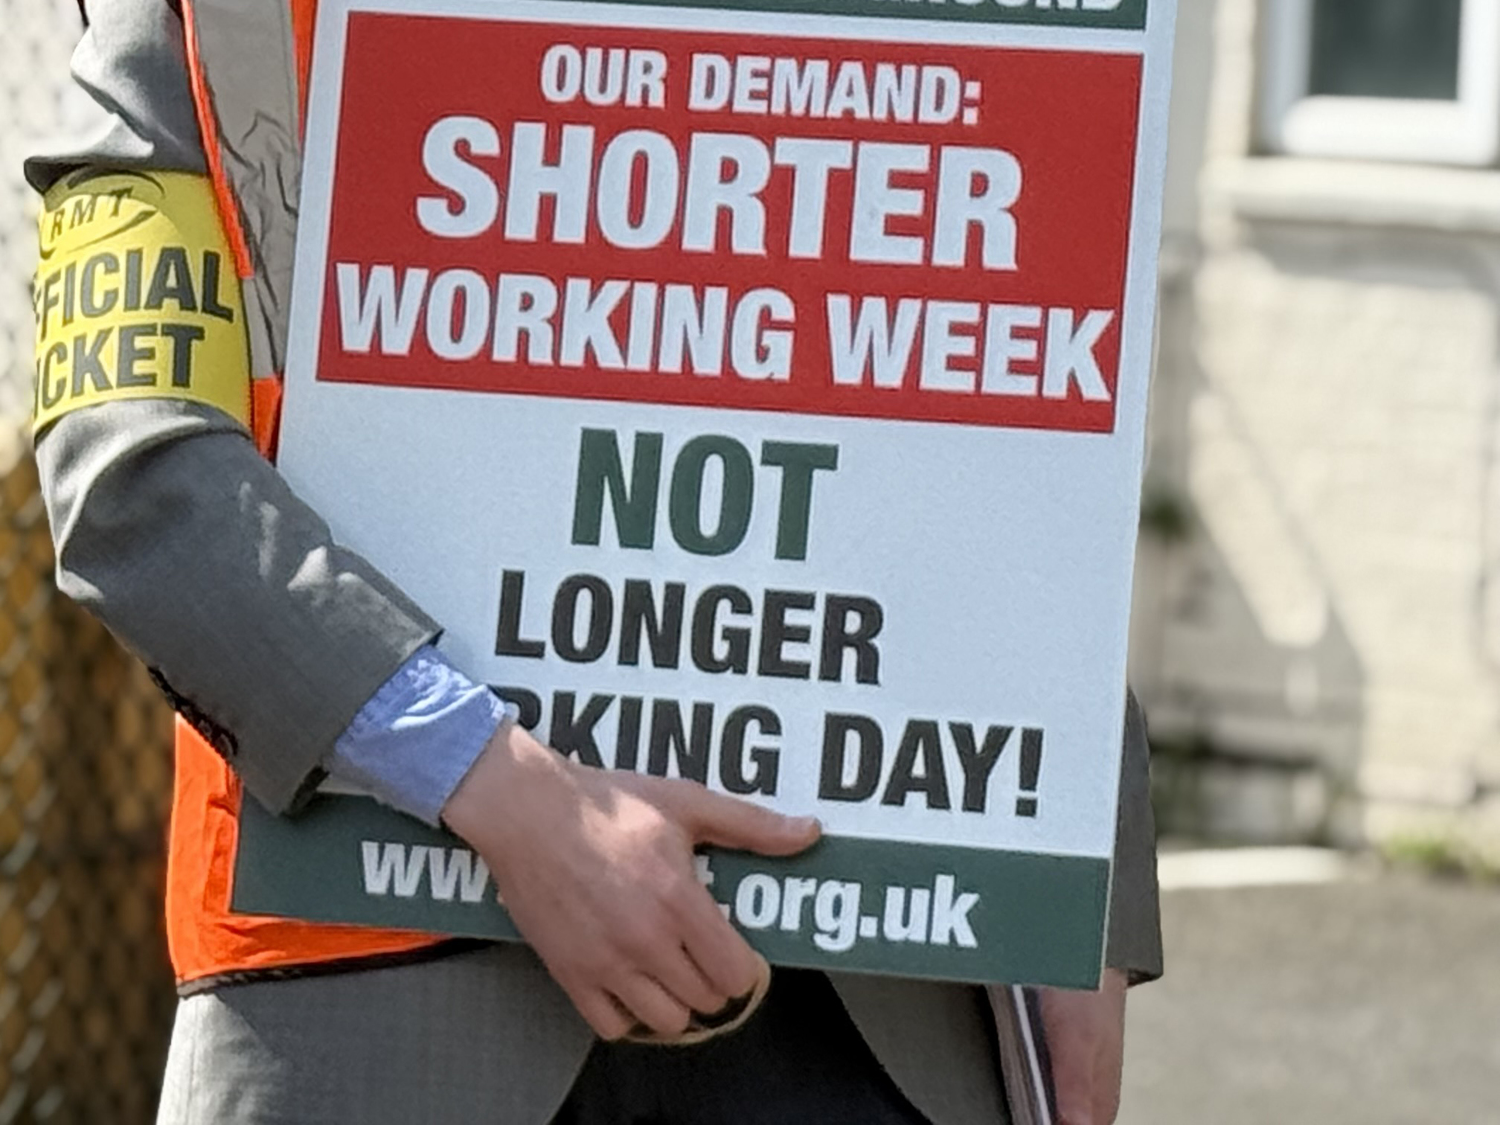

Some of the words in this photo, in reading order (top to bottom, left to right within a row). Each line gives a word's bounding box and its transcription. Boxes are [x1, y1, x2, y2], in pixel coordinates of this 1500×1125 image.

[541, 44, 666, 108] OUR
[688, 53, 981, 126] DEMAND:
[50, 187, 134, 244] RMT
[415, 115, 1023, 271] SHORTER
[31, 246, 234, 343] FICIAL
[335, 262, 796, 382] WORKING
[827, 296, 1115, 402] WEEK
[571, 427, 839, 562] NOT
[494, 569, 885, 686] LONGER
[818, 711, 1044, 818] DAY!
